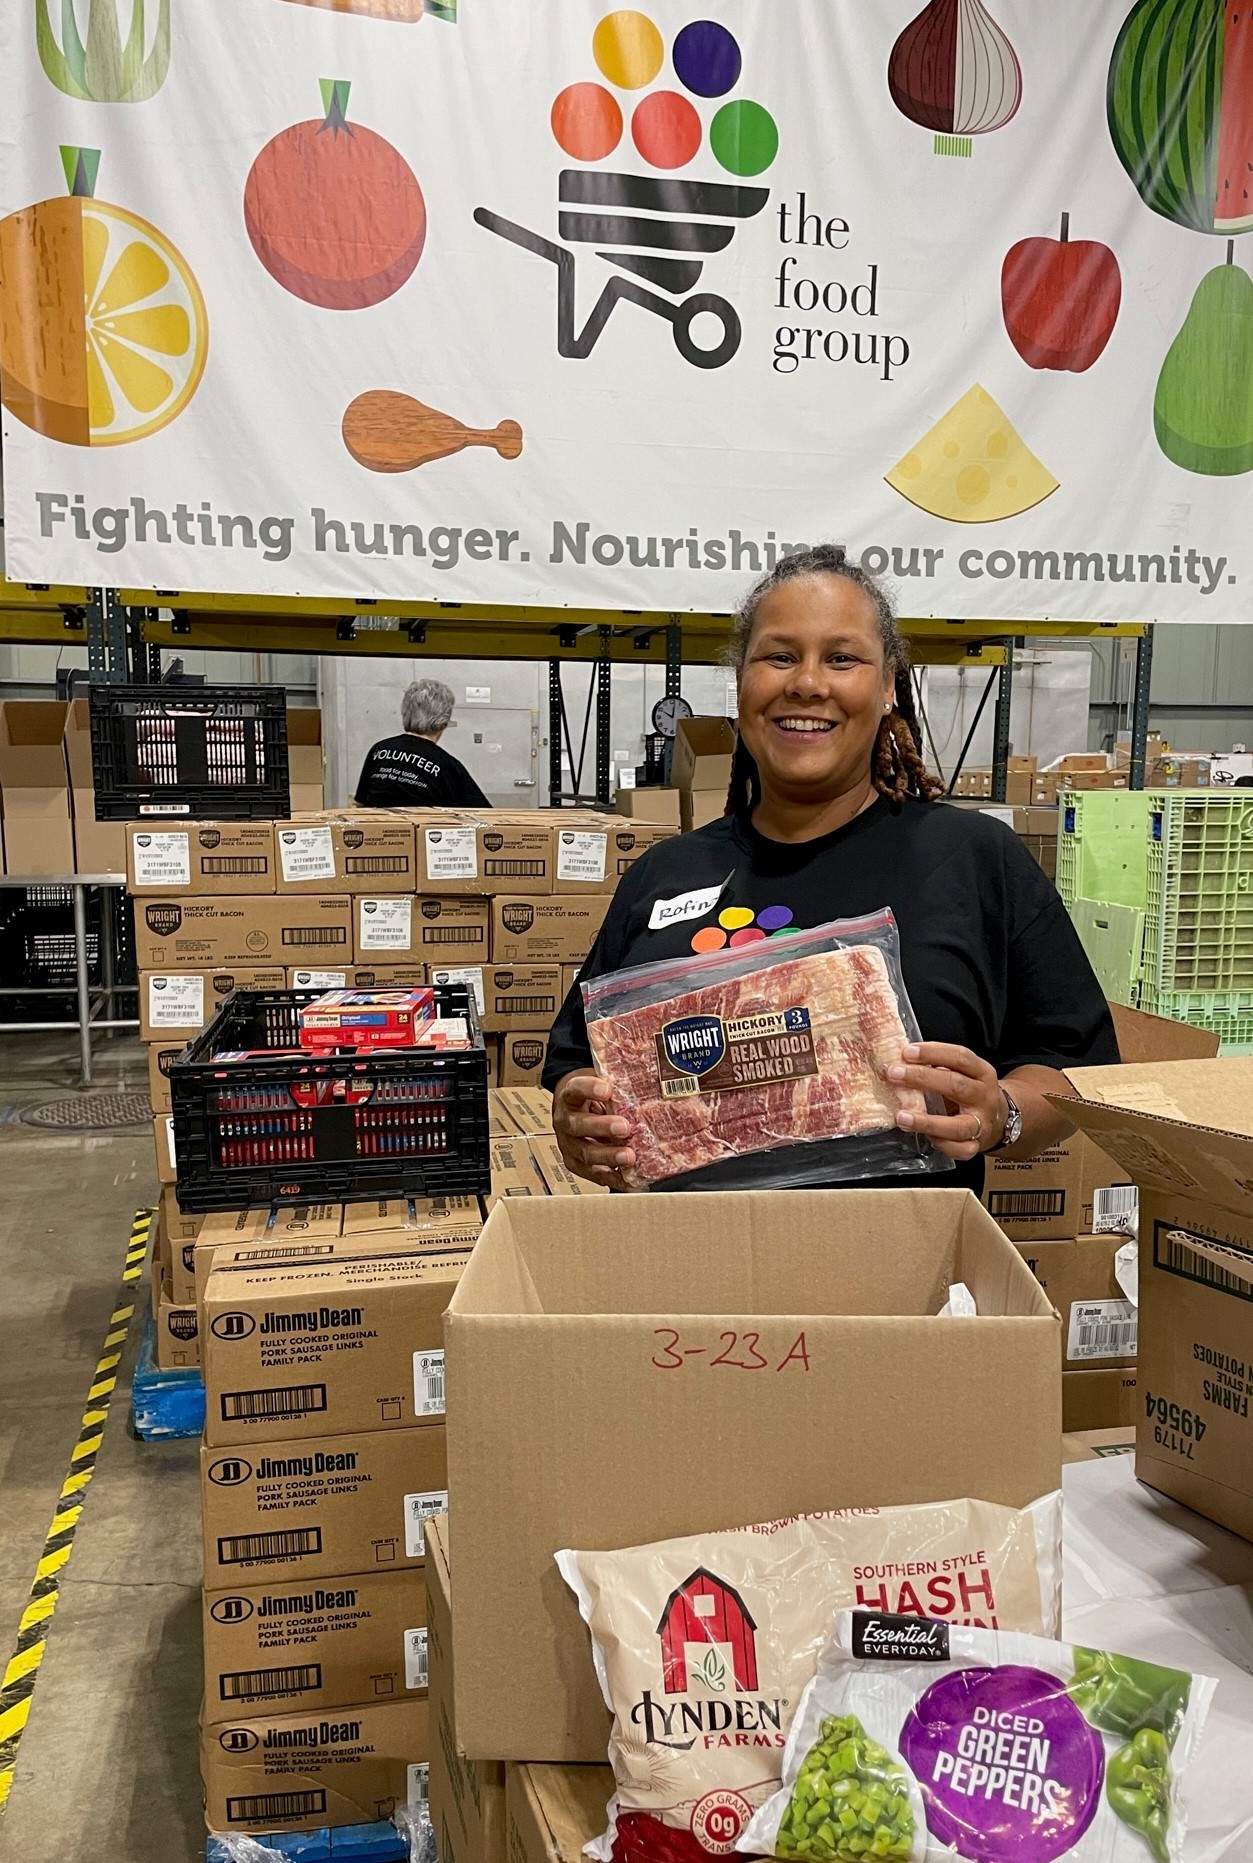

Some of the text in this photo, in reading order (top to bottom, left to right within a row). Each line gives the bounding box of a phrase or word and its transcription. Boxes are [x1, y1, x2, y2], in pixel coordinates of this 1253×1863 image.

[776, 192, 850, 249] the
[774, 257, 879, 316] food
[772, 326, 910, 381] group
[36, 492, 294, 561] Fighting
[311, 507, 530, 569] hunger.
[860, 545, 944, 577] our
[958, 545, 1238, 595] community.
[373, 749, 441, 777] VOLUNTEER
[147, 910, 180, 924] WRIGHT
[503, 910, 533, 921] WRIGHT
[728, 1014, 784, 1033] HICKORY
[791, 1009, 802, 1025] 3
[667, 1027, 719, 1055] WRIGHT
[757, 1028, 775, 1036] BACON
[514, 1047, 542, 1058] WRIGHT
[681, 1049, 711, 1060] BRAND
[730, 1034, 811, 1064] REAL WOOD
[733, 1057, 794, 1083] SMOKED
[246, 1276, 277, 1284] KEEP
[338, 1264, 428, 1277] MERCHANDISE
[346, 1276, 385, 1284] Single
[260, 1307, 364, 1334] Jimmy Dean
[260, 1330, 379, 1348] FULLY COOKED ORIGINAL
[261, 1340, 363, 1358] PORK SAUSAGE LINKS
[652, 1328, 811, 1372] 3-23 A
[261, 1354, 322, 1367] FAMILY PACK
[1193, 1343, 1245, 1379] POTATOES
[1216, 1371, 1244, 1393] STYLE
[1203, 1380, 1248, 1418] FARMS
[259, 1415, 279, 1423] 77900
[1145, 1391, 1207, 1442] 49564
[1154, 1426, 1195, 1461] 71179
[256, 1452, 358, 1480] Jimmy Dean
[256, 1474, 373, 1493] FULLY COOKED ORIGINAL
[257, 1484, 358, 1502] PORK SAUSAGE LINKS
[257, 1498, 317, 1511] FAMILY PACK
[752, 1513, 800, 1537] BROWN
[853, 1550, 987, 1581] SOUTHERN STYLE
[257, 1589, 358, 1618] Jimmy Dean
[855, 1569, 995, 1617] HASH
[258, 1611, 371, 1631] FULLY COOKED ORIGINAL
[258, 1621, 358, 1640] PORK SAUSAGE LINKS
[862, 1620, 938, 1645] Essential
[258, 1634, 318, 1649] FAMILY PACK
[864, 1643, 937, 1656] EVERYDAY
[630, 1690, 783, 1750] LYNDEN
[972, 1706, 1045, 1735] DICED
[263, 1721, 362, 1749] Jimmy Dean
[703, 1733, 786, 1750] FARMS
[263, 1745, 375, 1760] FULLY COOKED ORIGINAL
[292, 1757, 333, 1765] SAUSAGE
[957, 1725, 1051, 1774] GREEN
[264, 1765, 322, 1775] FAMILY PACK
[932, 1750, 1065, 1816] PEPPERS
[694, 1793, 751, 1828] ZERO GRAMS
[710, 1812, 735, 1837] 0g
[699, 1833, 732, 1852] TRANS
